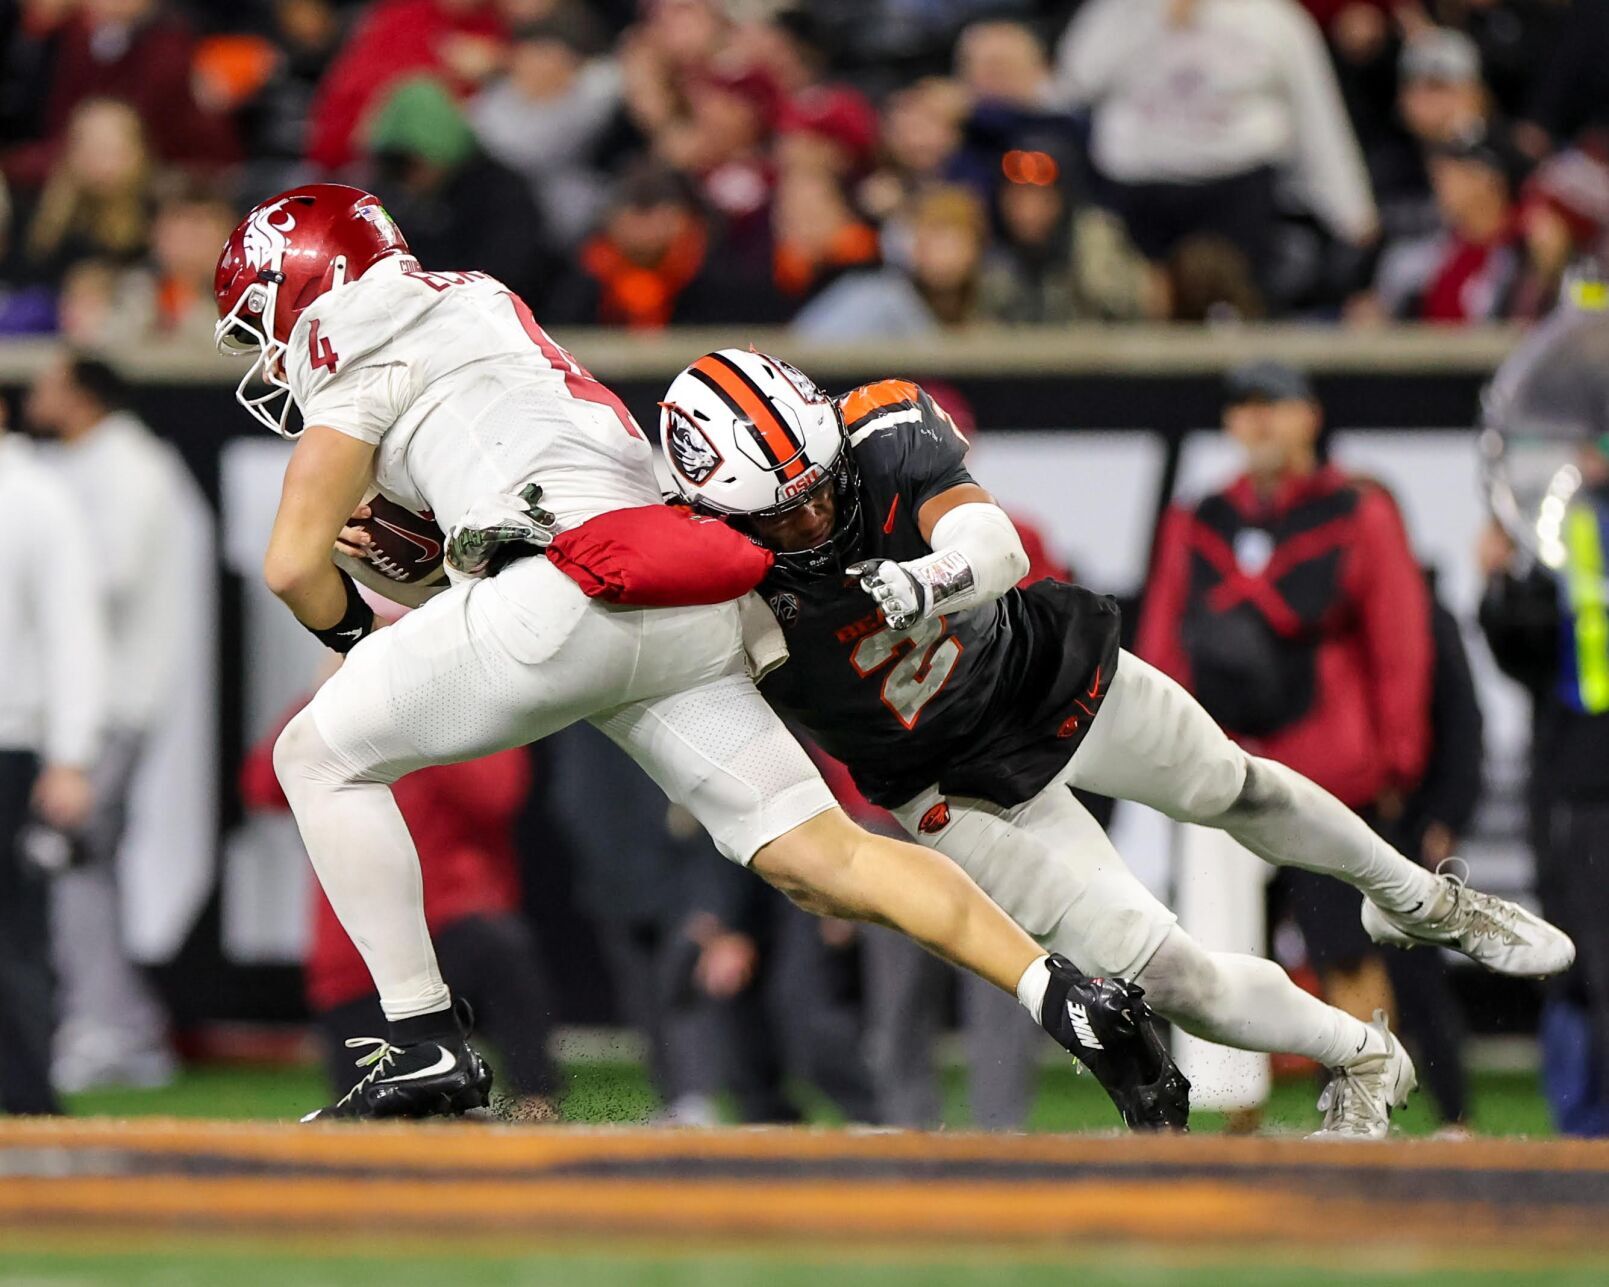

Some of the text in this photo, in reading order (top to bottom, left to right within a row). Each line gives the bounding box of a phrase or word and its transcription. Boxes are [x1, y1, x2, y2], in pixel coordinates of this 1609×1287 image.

[307, 318, 339, 375] 4
[784, 468, 820, 498] OSU
[849, 614, 964, 731] 2
[1066, 999, 1105, 1050] NIKE
